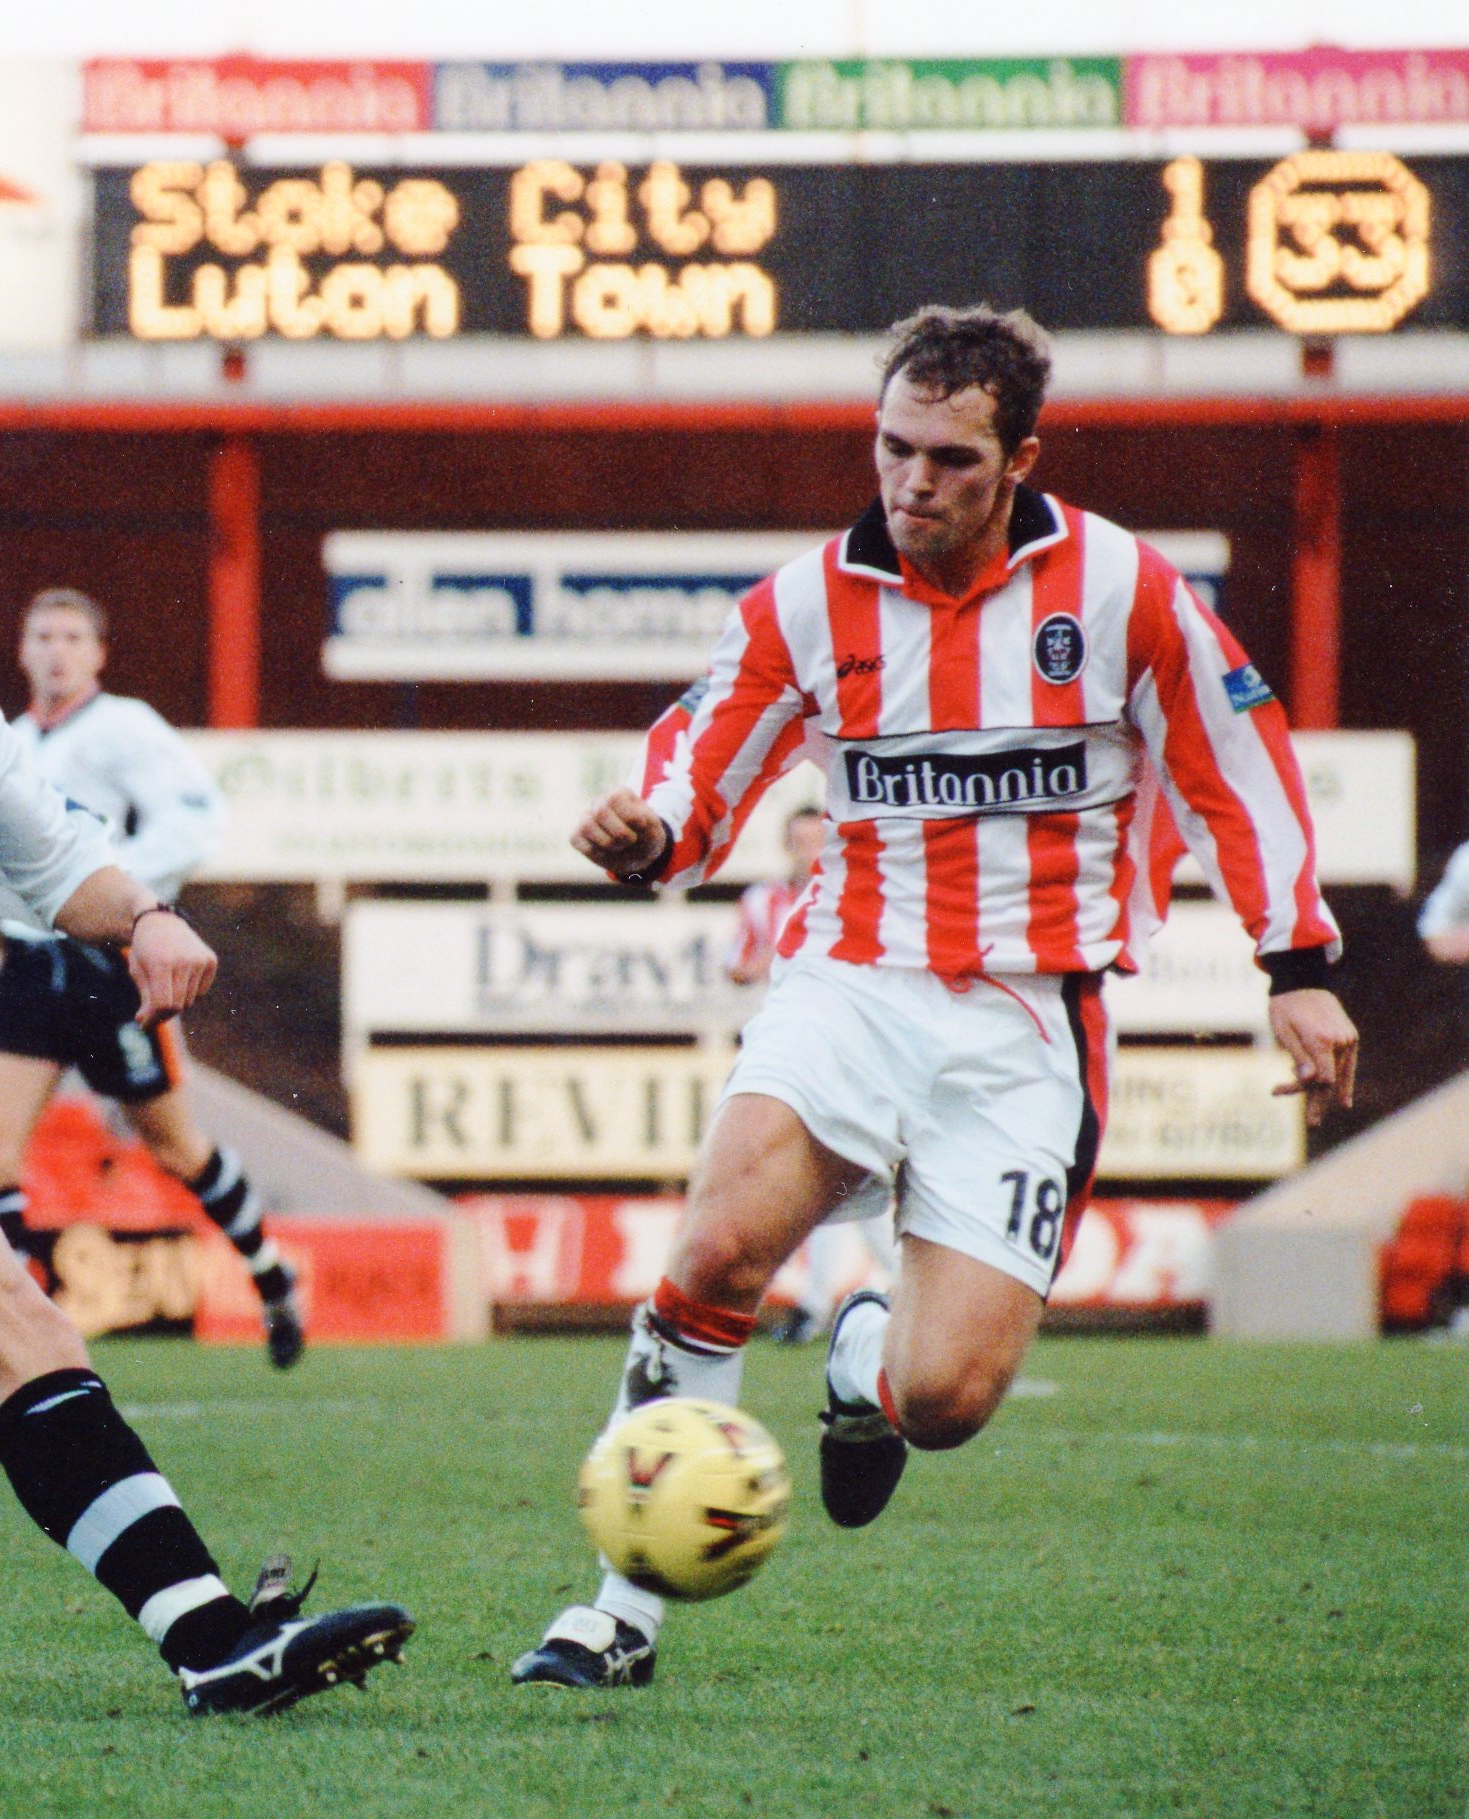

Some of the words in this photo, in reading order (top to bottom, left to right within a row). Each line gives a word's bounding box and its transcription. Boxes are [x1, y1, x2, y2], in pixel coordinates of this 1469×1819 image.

[440, 62, 766, 131] Britannia
[784, 58, 1114, 128] Britannia
[131, 160, 458, 256] Stoke
[510, 160, 776, 256] City
[1163, 156, 1212, 247] 1
[131, 243, 458, 339] Luton
[510, 243, 776, 339] Town
[856, 756, 1078, 805] Britannia
[473, 922, 716, 990] Drayt
[1000, 1169, 1064, 1261] 18
